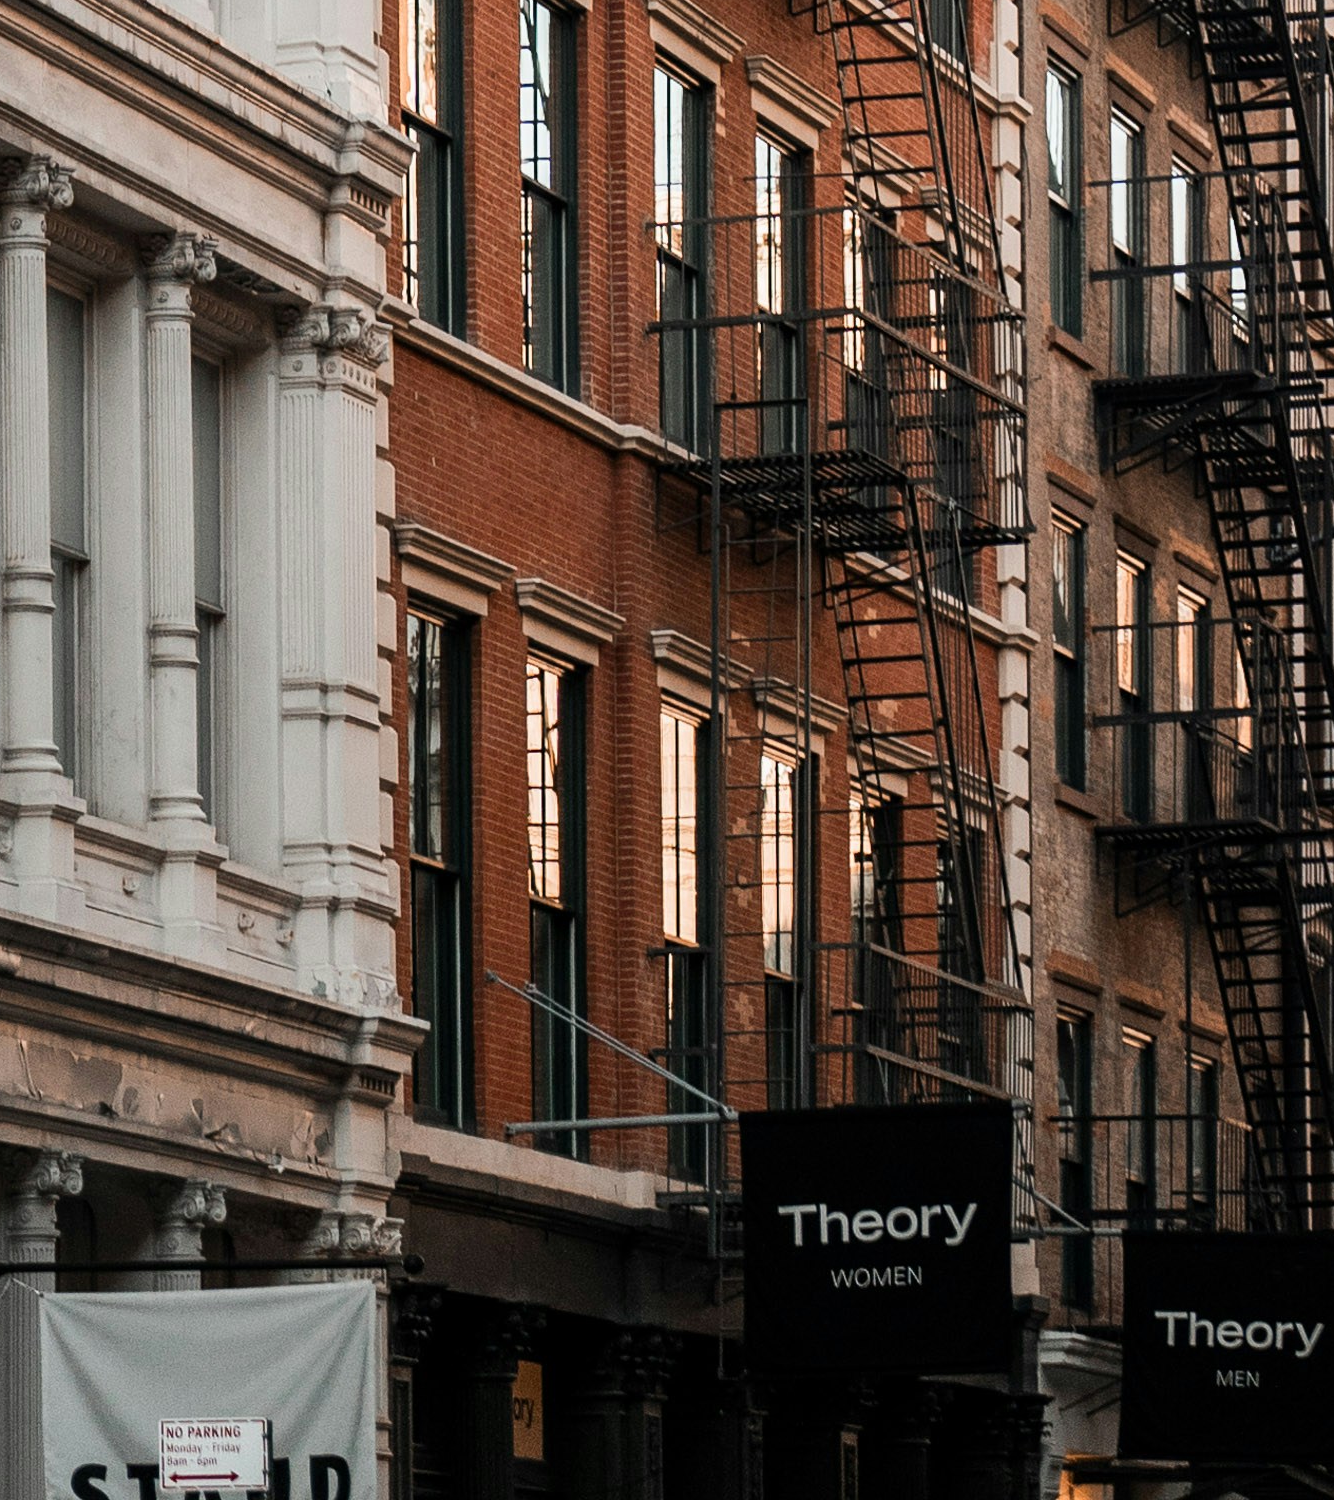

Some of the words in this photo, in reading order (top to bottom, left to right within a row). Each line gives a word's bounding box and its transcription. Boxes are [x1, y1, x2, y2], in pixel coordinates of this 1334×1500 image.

[778, 1203, 978, 1247] Theory
[830, 1266, 923, 1289] WOMEN
[1154, 1311, 1325, 1357] Theory
[1216, 1369, 1260, 1388] MEN
[166, 1426, 183, 1439] NO
[187, 1425, 241, 1438] PARKING
[167, 1443, 202, 1453] Monday
[212, 1442, 241, 1454] Friday
